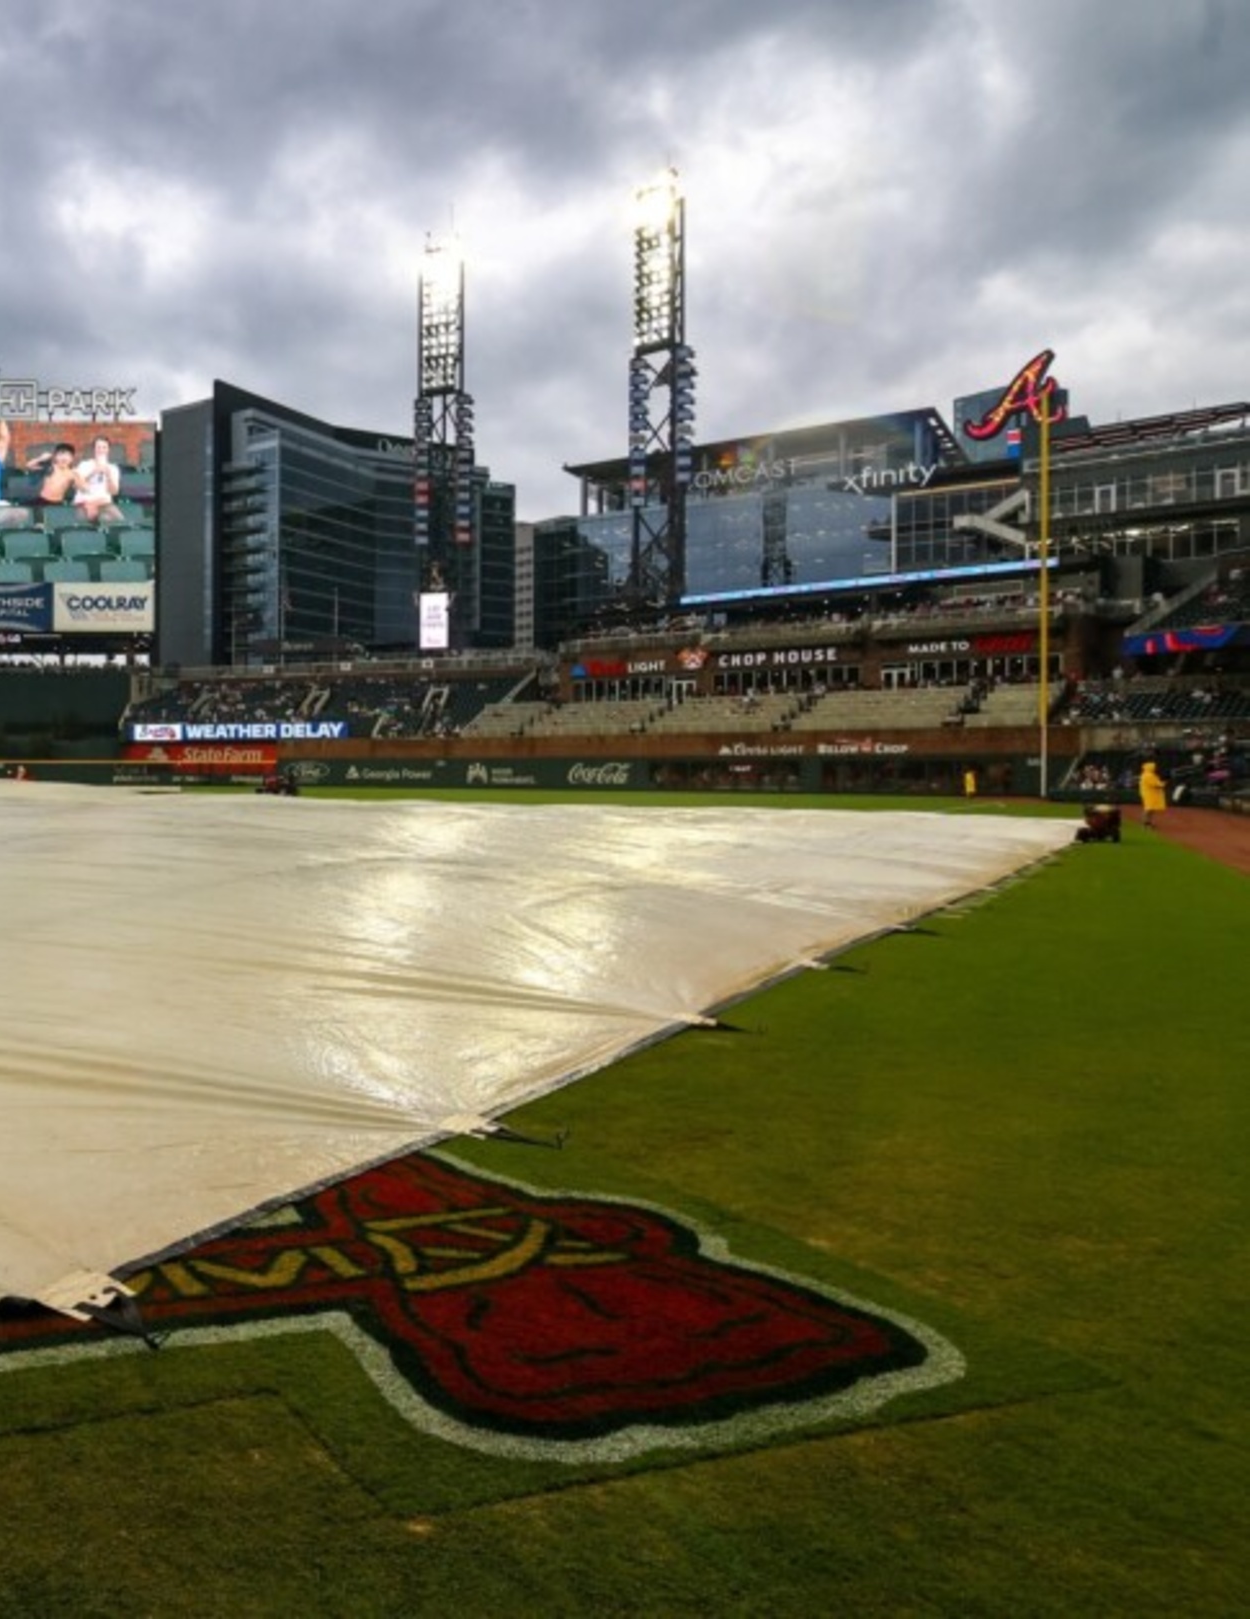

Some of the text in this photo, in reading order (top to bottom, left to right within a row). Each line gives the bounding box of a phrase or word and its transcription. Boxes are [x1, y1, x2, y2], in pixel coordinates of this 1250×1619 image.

[48, 388, 138, 415] PARK
[688, 458, 796, 491] OMCAST
[843, 460, 938, 494] xfinity
[66, 595, 148, 611] COOLRAY
[908, 641, 946, 654] MADE
[951, 640, 970, 651] TO
[627, 659, 666, 673] LIGHT
[718, 648, 837, 667] CHOP HOUSE
[185, 723, 279, 739] WEATHER
[280, 721, 345, 738] DELAY
[362, 768, 432, 781] Georgia Power
[567, 762, 632, 784] Coca-Cola
